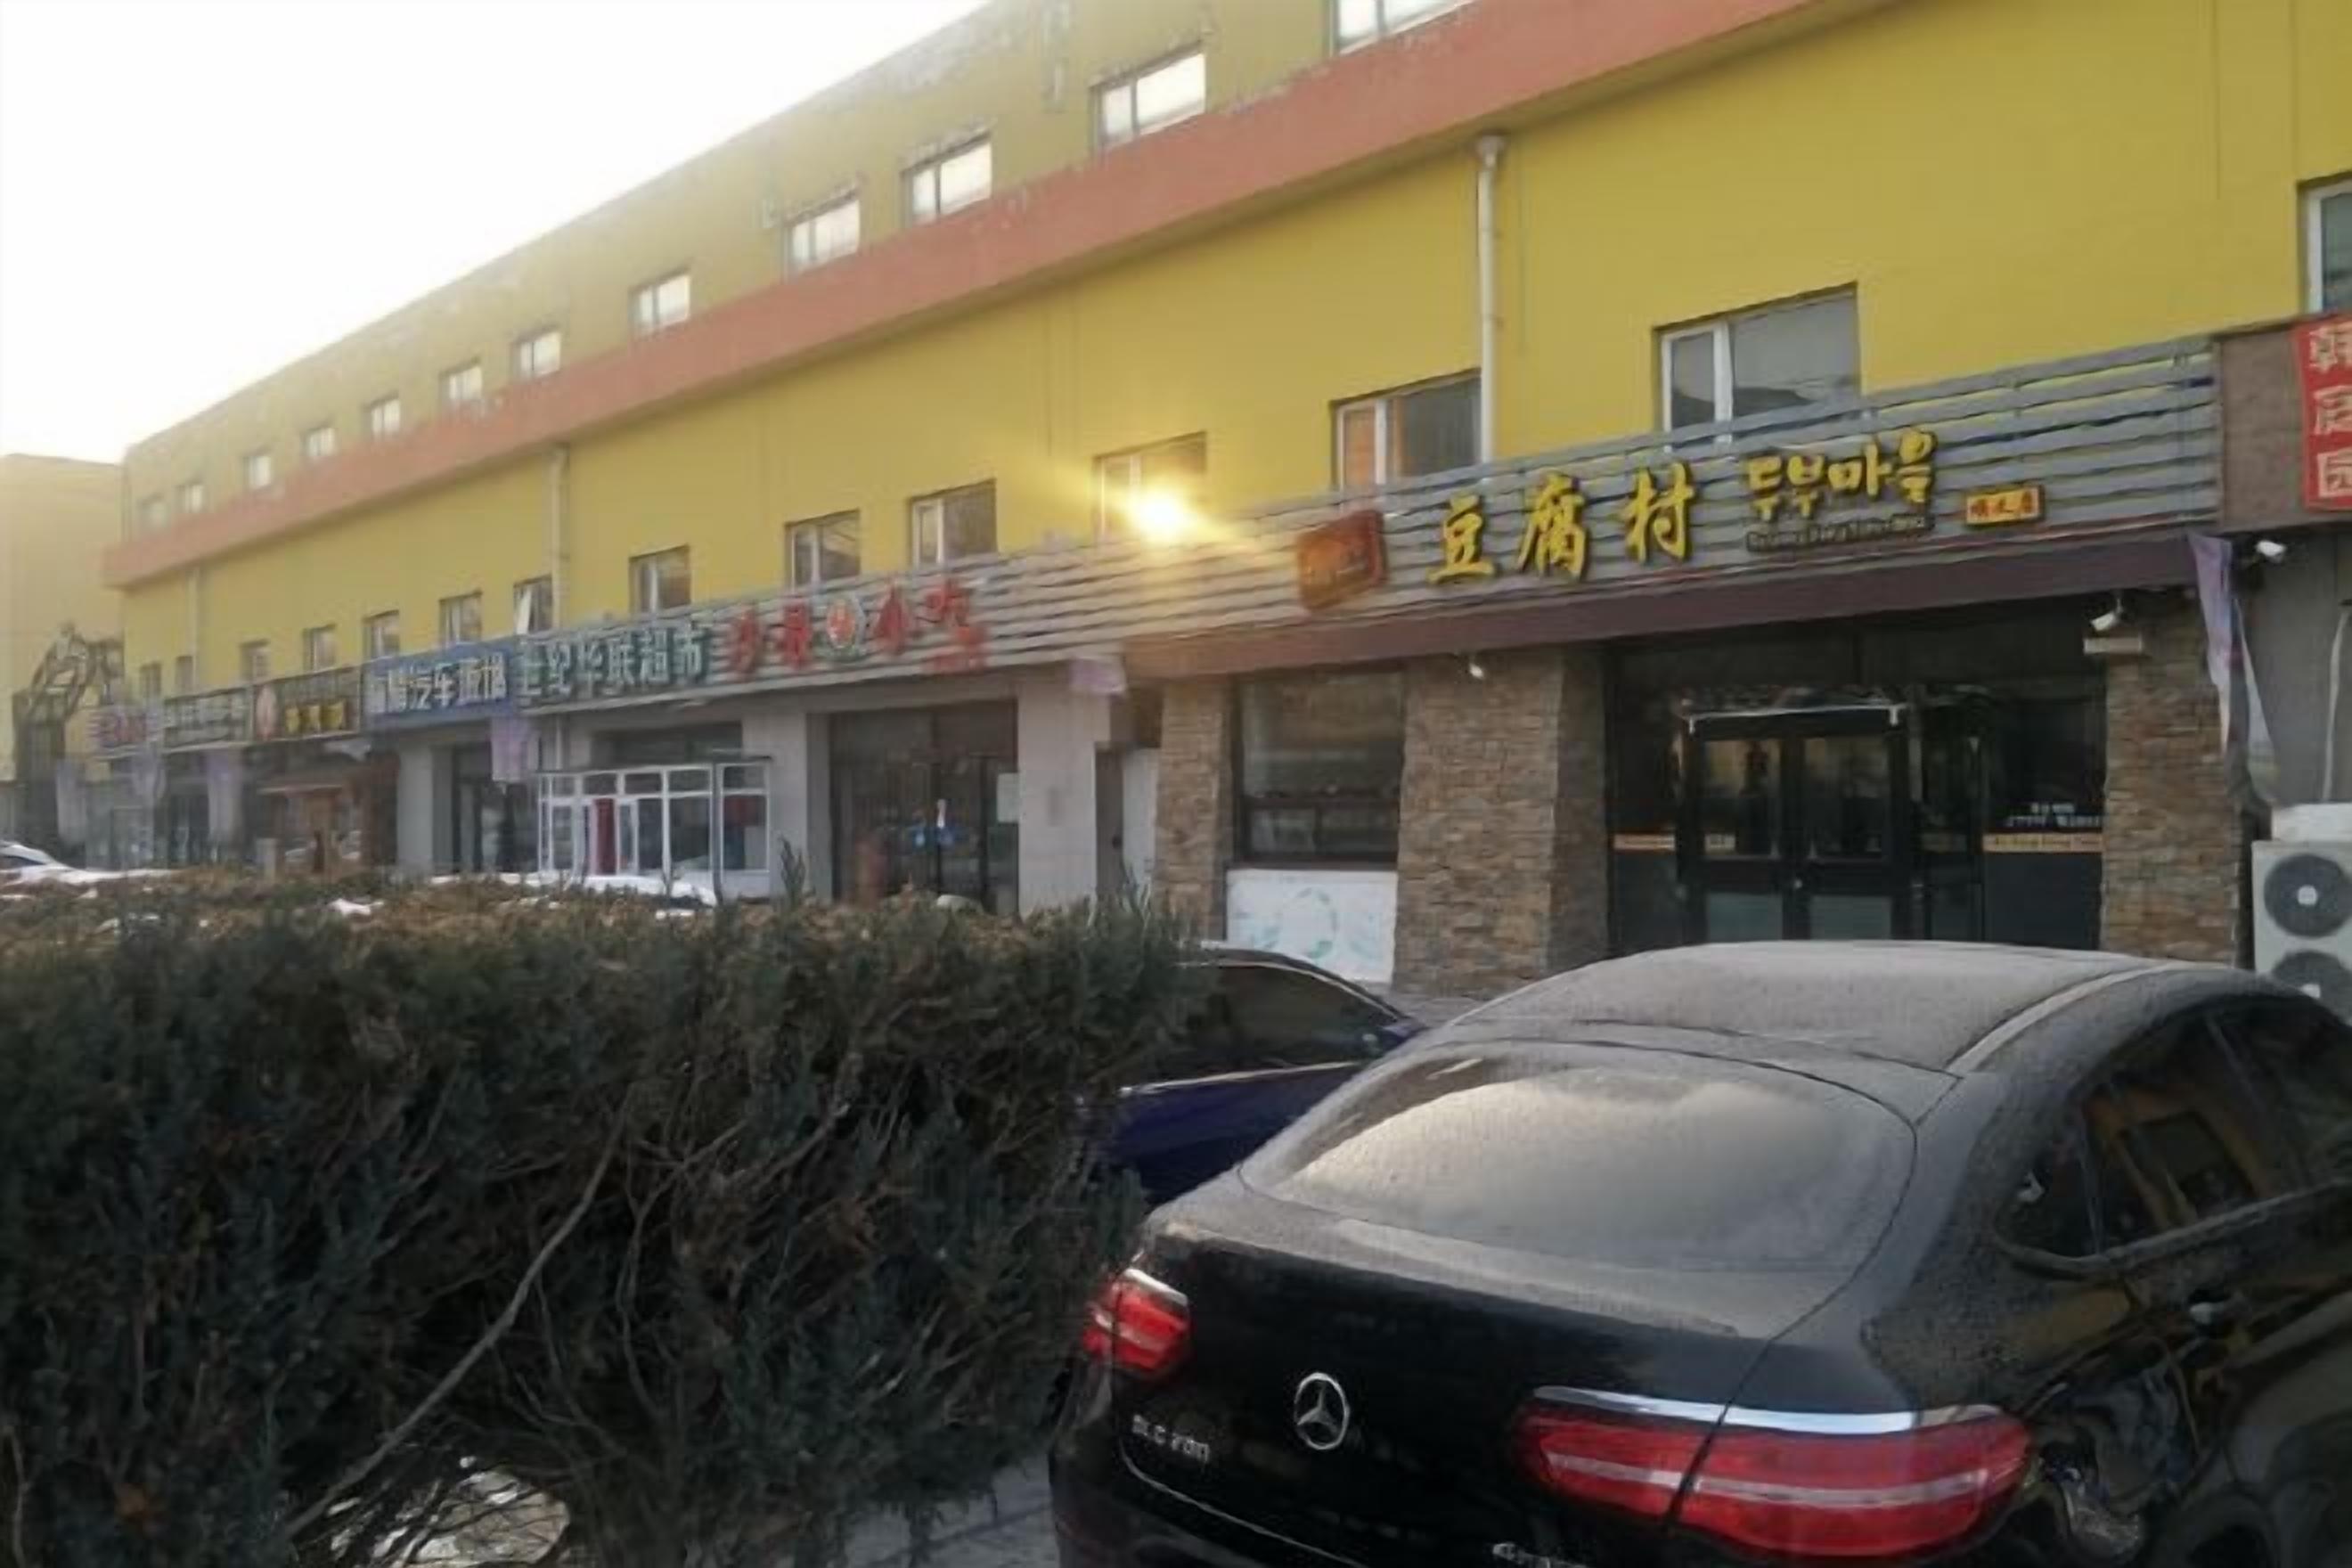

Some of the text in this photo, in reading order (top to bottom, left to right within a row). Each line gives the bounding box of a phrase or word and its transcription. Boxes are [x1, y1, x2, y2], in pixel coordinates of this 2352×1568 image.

[1426, 461, 1695, 584] 豆腐村
[1747, 430, 1935, 521] 두부마을
